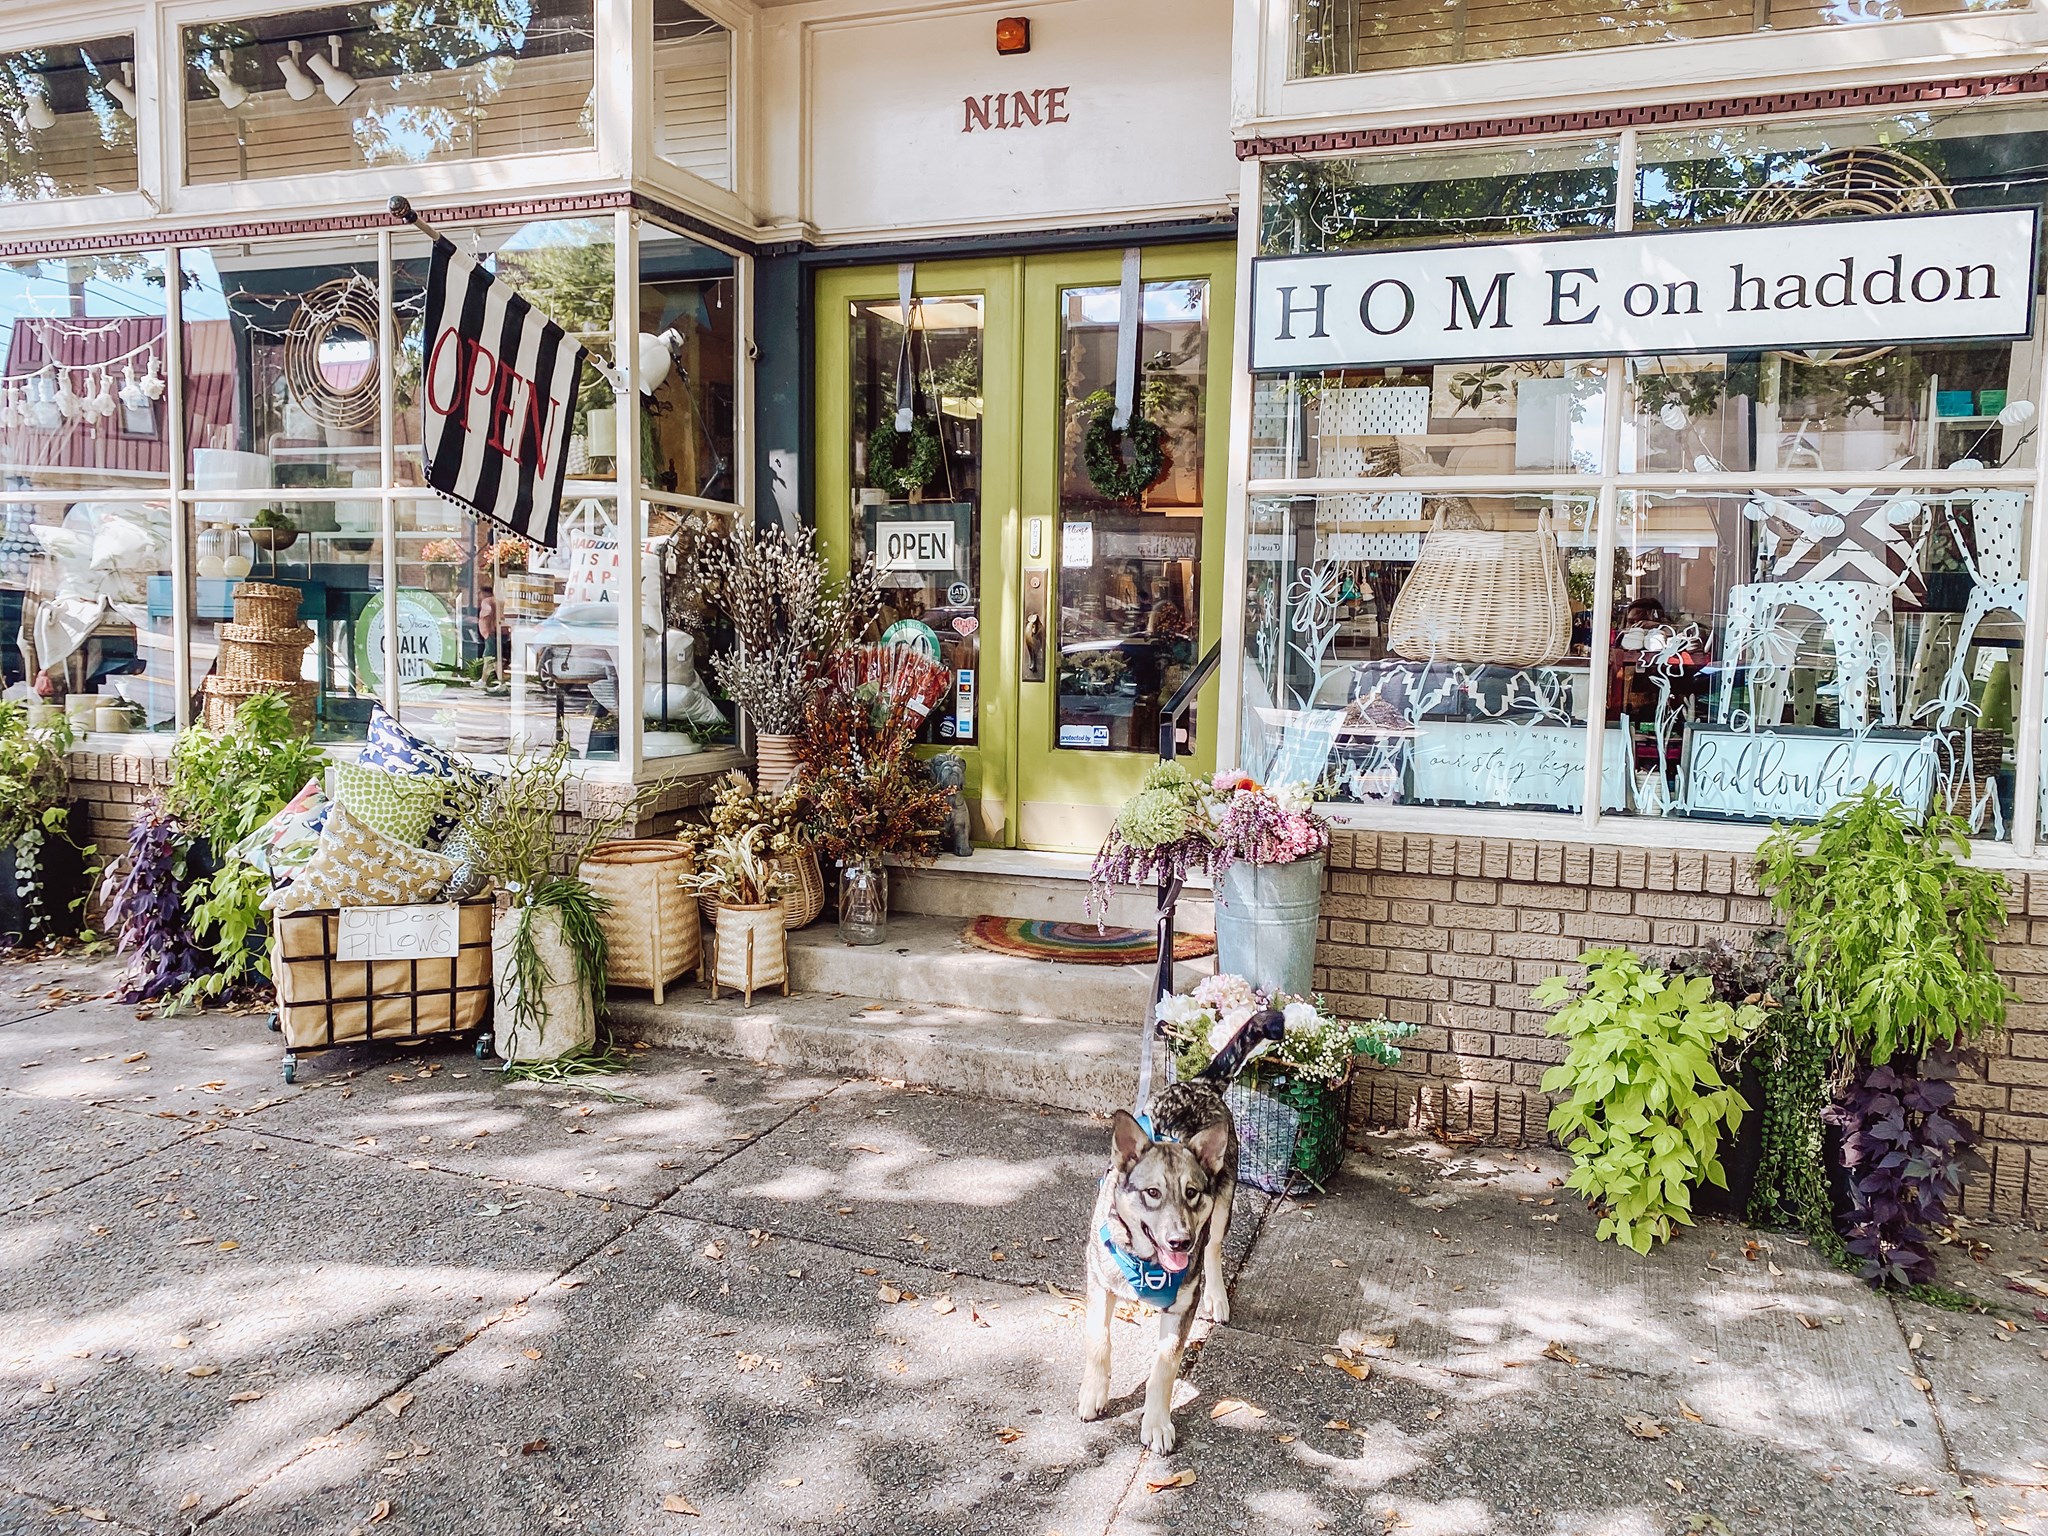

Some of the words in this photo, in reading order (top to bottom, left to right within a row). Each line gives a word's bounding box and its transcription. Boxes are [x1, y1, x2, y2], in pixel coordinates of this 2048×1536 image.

[962, 86, 1070, 133] NINE
[1275, 267, 1600, 341] HOME
[1623, 280, 1703, 317] on
[1727, 254, 2001, 312] haddon
[428, 326, 560, 481] OPEN
[887, 532, 946, 560] OPEN
[582, 553, 599, 566] IS
[380, 636, 429, 654] CALK
[384, 658, 424, 677] AINT
[1094, 728, 1107, 738] ADT
[1464, 732, 1493, 741] OME
[1531, 733, 1578, 748] WHERE
